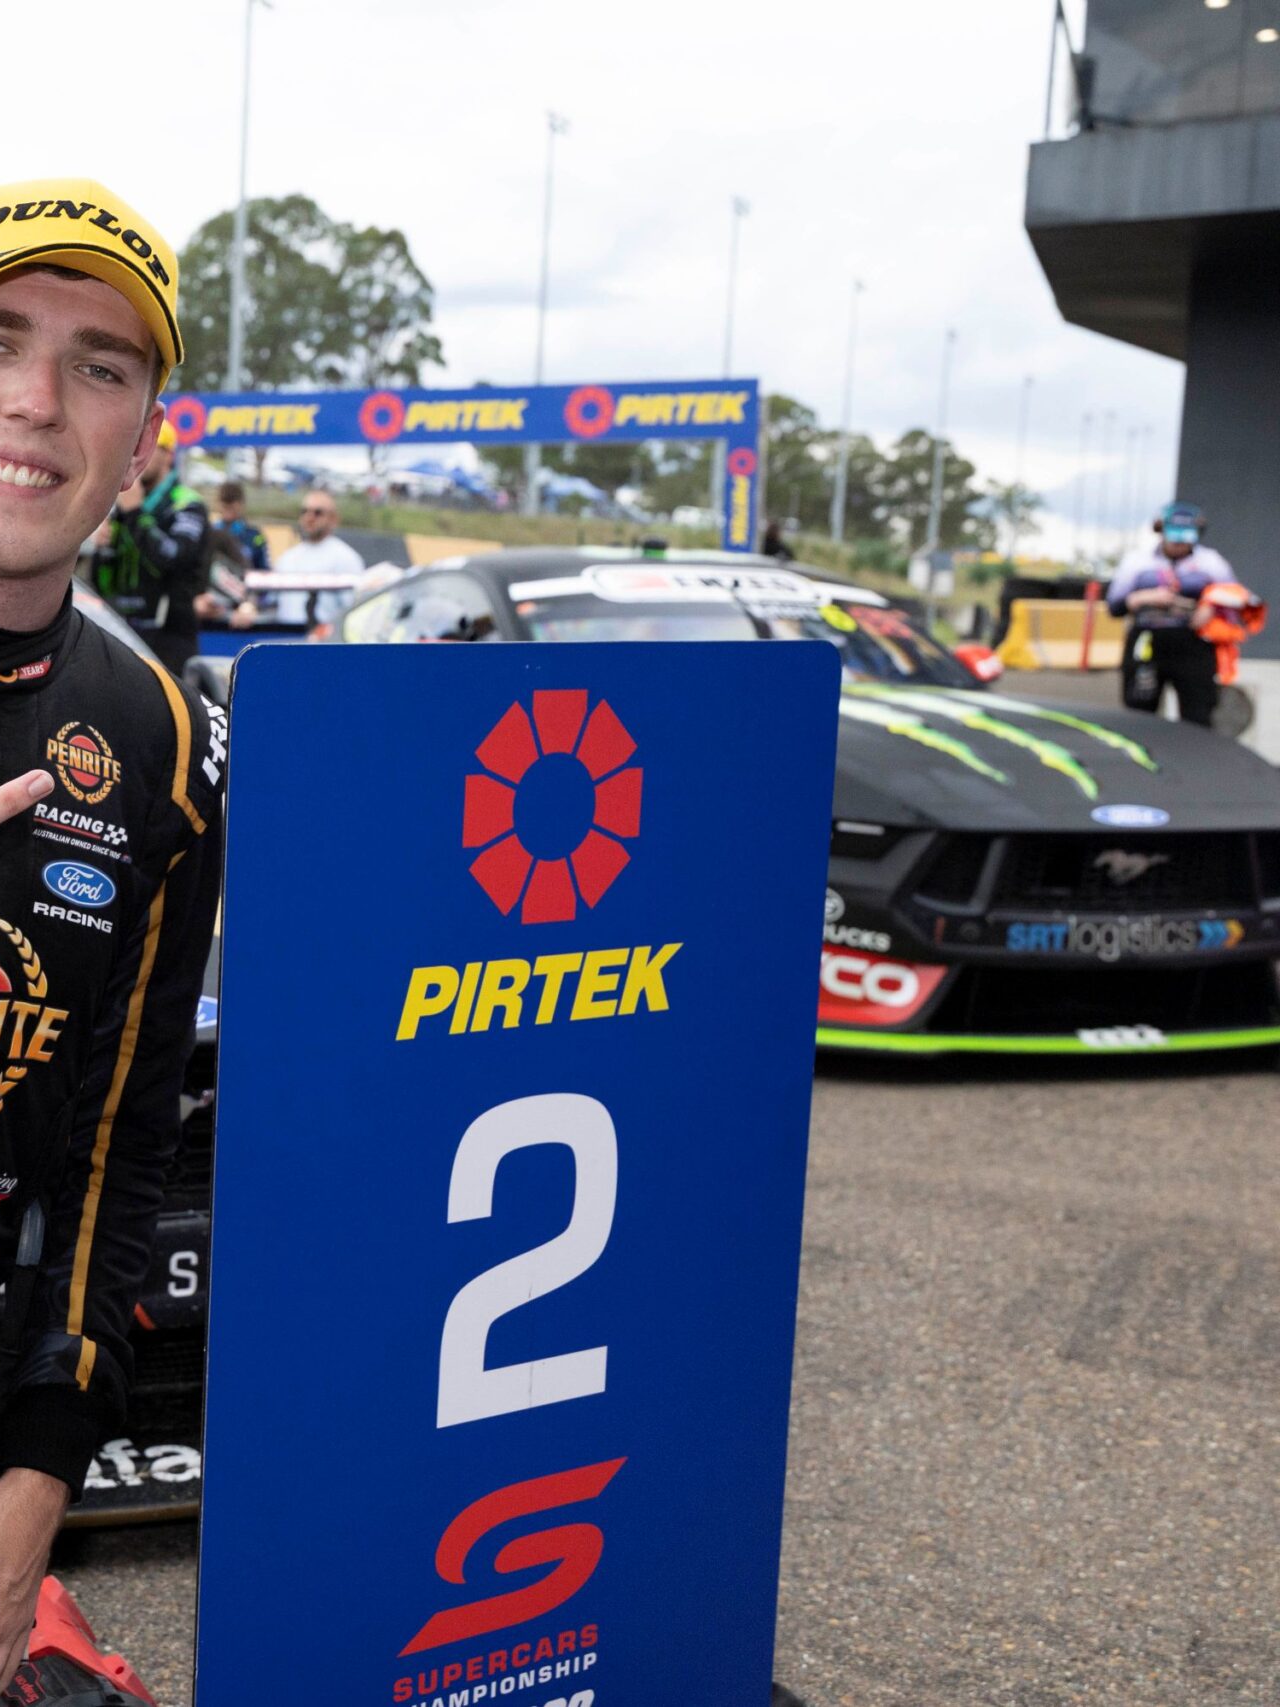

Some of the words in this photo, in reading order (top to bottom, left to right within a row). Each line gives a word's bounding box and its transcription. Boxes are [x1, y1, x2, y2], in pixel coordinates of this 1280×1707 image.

[206, 405, 317, 436] PIRTEK
[404, 400, 527, 431] PIRTEK
[615, 393, 749, 427] PIRTEK
[21, 663, 45, 677] YEARS
[46, 738, 122, 784] PENRITE
[34, 803, 105, 833] RACING
[32, 828, 71, 845] AUSTRALIAN
[70, 838, 92, 850] OWNED
[91, 844, 110, 856] SINCE
[57, 866, 102, 901] Ford
[33, 901, 114, 933] RACING
[395, 943, 684, 1041] PIRTEK
[436, 1092, 618, 1429] 2
[393, 1623, 599, 1703] SUPERCARS
